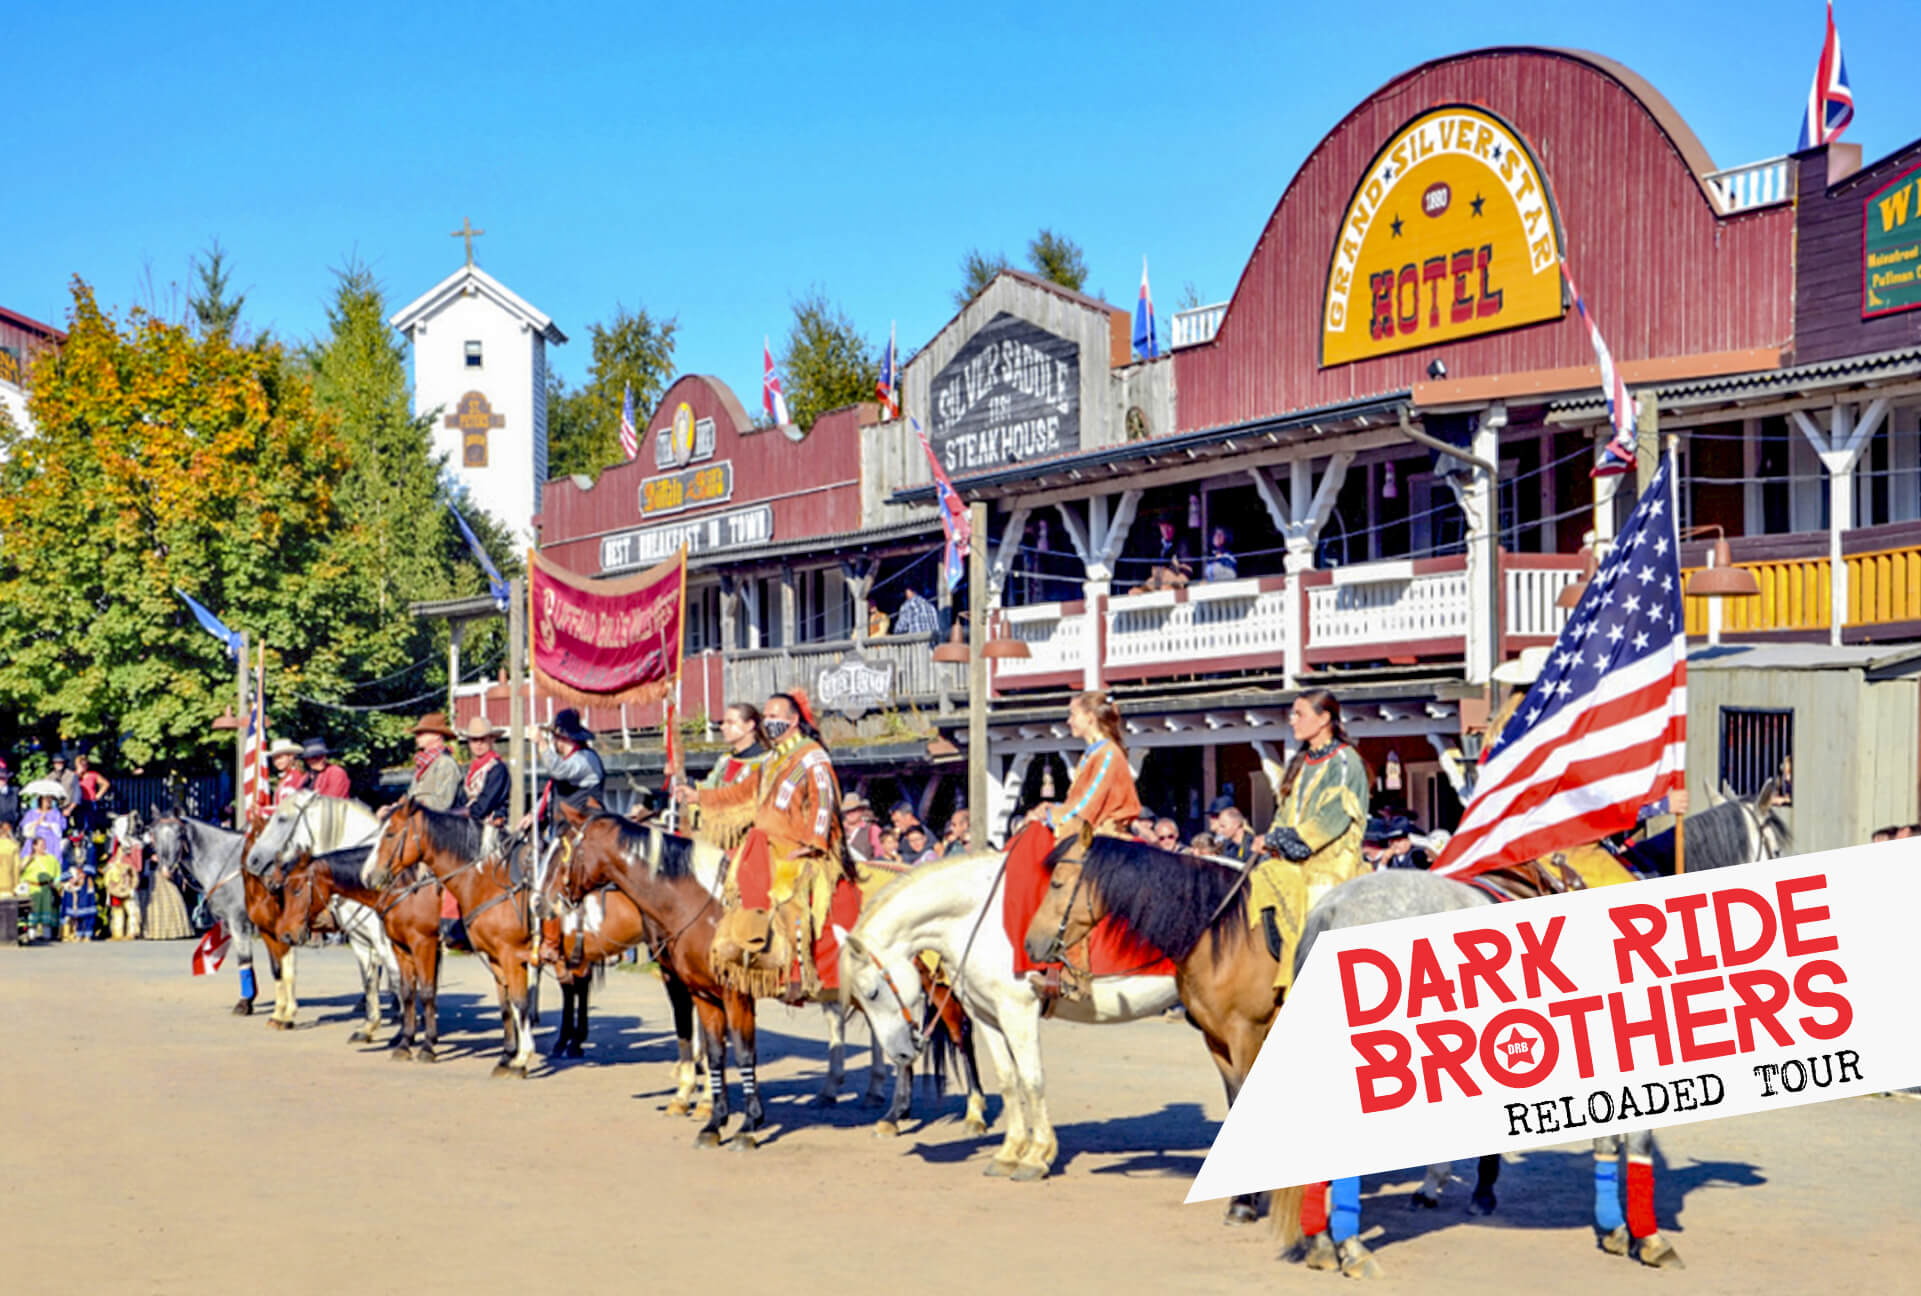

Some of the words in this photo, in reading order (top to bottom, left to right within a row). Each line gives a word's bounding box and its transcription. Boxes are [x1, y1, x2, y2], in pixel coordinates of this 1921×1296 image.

[1329, 176, 1385, 328] GRAND
[1391, 118, 1495, 178] SILVER
[1499, 148, 1554, 270] STAR
[1369, 242, 1503, 341] HOTEL
[938, 343, 1000, 427] SILVER
[1002, 339, 1070, 415] SADDLE
